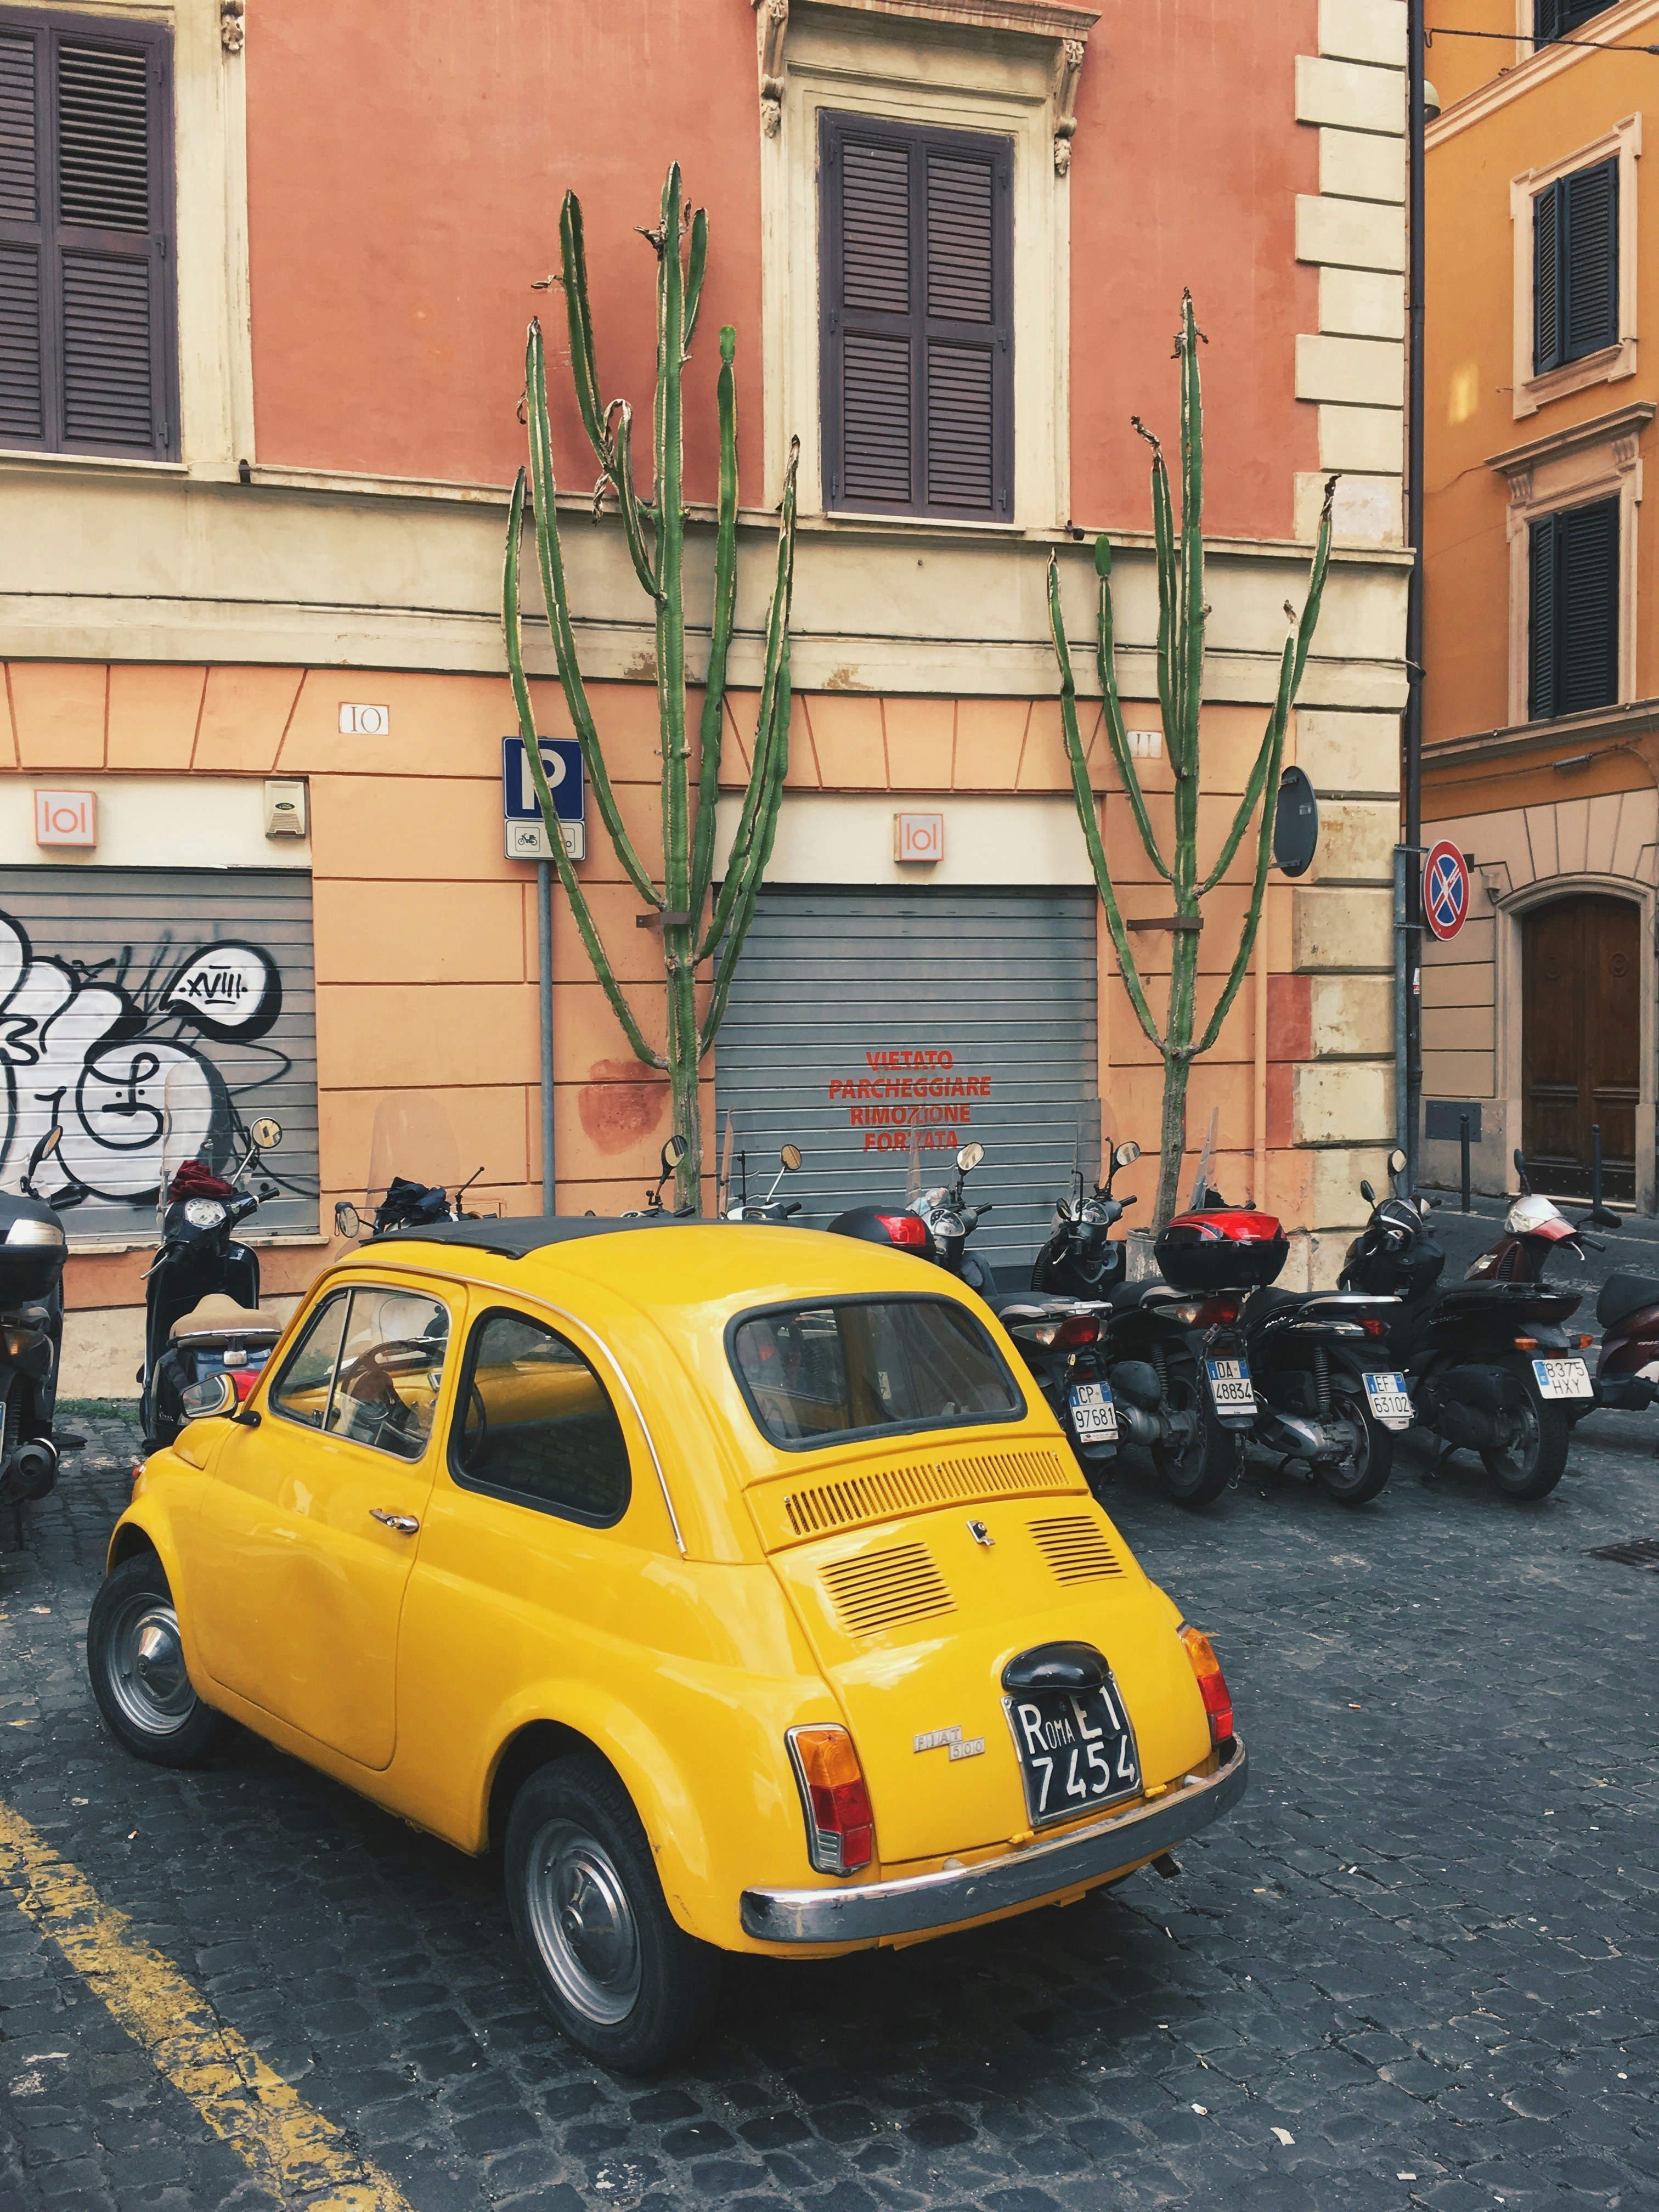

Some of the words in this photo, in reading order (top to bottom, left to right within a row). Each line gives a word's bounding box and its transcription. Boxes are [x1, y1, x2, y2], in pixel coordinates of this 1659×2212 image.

[521, 748, 566, 810] P
[866, 1050, 953, 1071] VIETATO
[829, 1076, 991, 1099] PARCHEGGIARE
[850, 1104, 970, 1126] RIMOZIONE
[1217, 1362, 1233, 1378] DA
[1545, 1362, 1584, 1378] 8375
[1216, 1383, 1251, 1400] 48834
[1375, 1376, 1389, 1392] EF
[1551, 1378, 1580, 1394] HXY
[1079, 1386, 1093, 1403] CP
[1374, 1396, 1409, 1413] 63102
[1075, 1407, 1114, 1427] 97681
[917, 1728, 960, 1750] FIAT
[952, 1741, 982, 1757] 500
[1032, 1735, 1135, 1812] 7454
